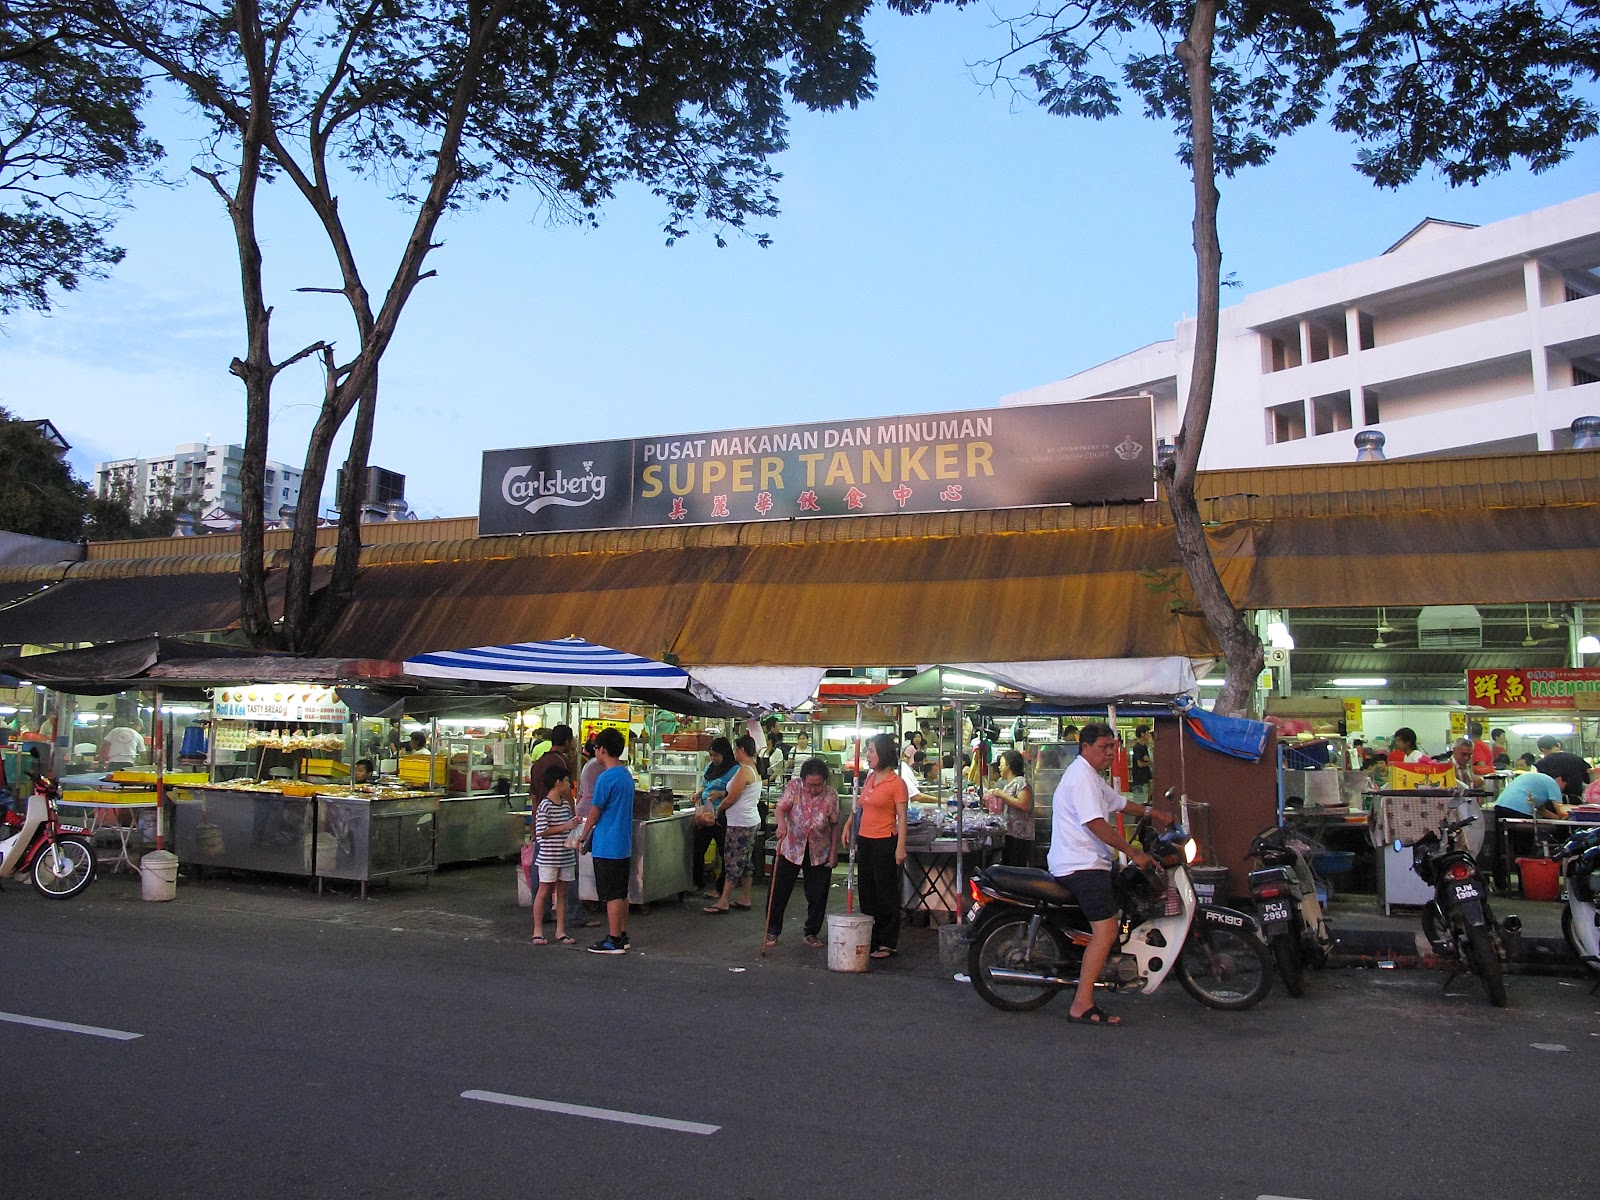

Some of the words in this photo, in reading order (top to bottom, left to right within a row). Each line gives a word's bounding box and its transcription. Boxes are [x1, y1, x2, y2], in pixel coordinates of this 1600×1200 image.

[643, 440, 706, 462] PUSAT
[710, 431, 818, 457] MAKANAN
[824, 427, 871, 449] DAN
[877, 416, 993, 445] MINUMAN
[641, 456, 785, 498] SUPER
[798, 441, 995, 488] TANKER
[501, 464, 607, 514] Carlsberg
[216, 703, 229, 716] Roti
[234, 703, 246, 716] Kek
[247, 705, 264, 713] TASTY
[264, 705, 283, 714] BREAD
[1455, 884, 1473, 894] PJW
[1265, 902, 1283, 913] PCJ
[1205, 911, 1243, 927] PFK1913
[1263, 910, 1288, 921] 2959
